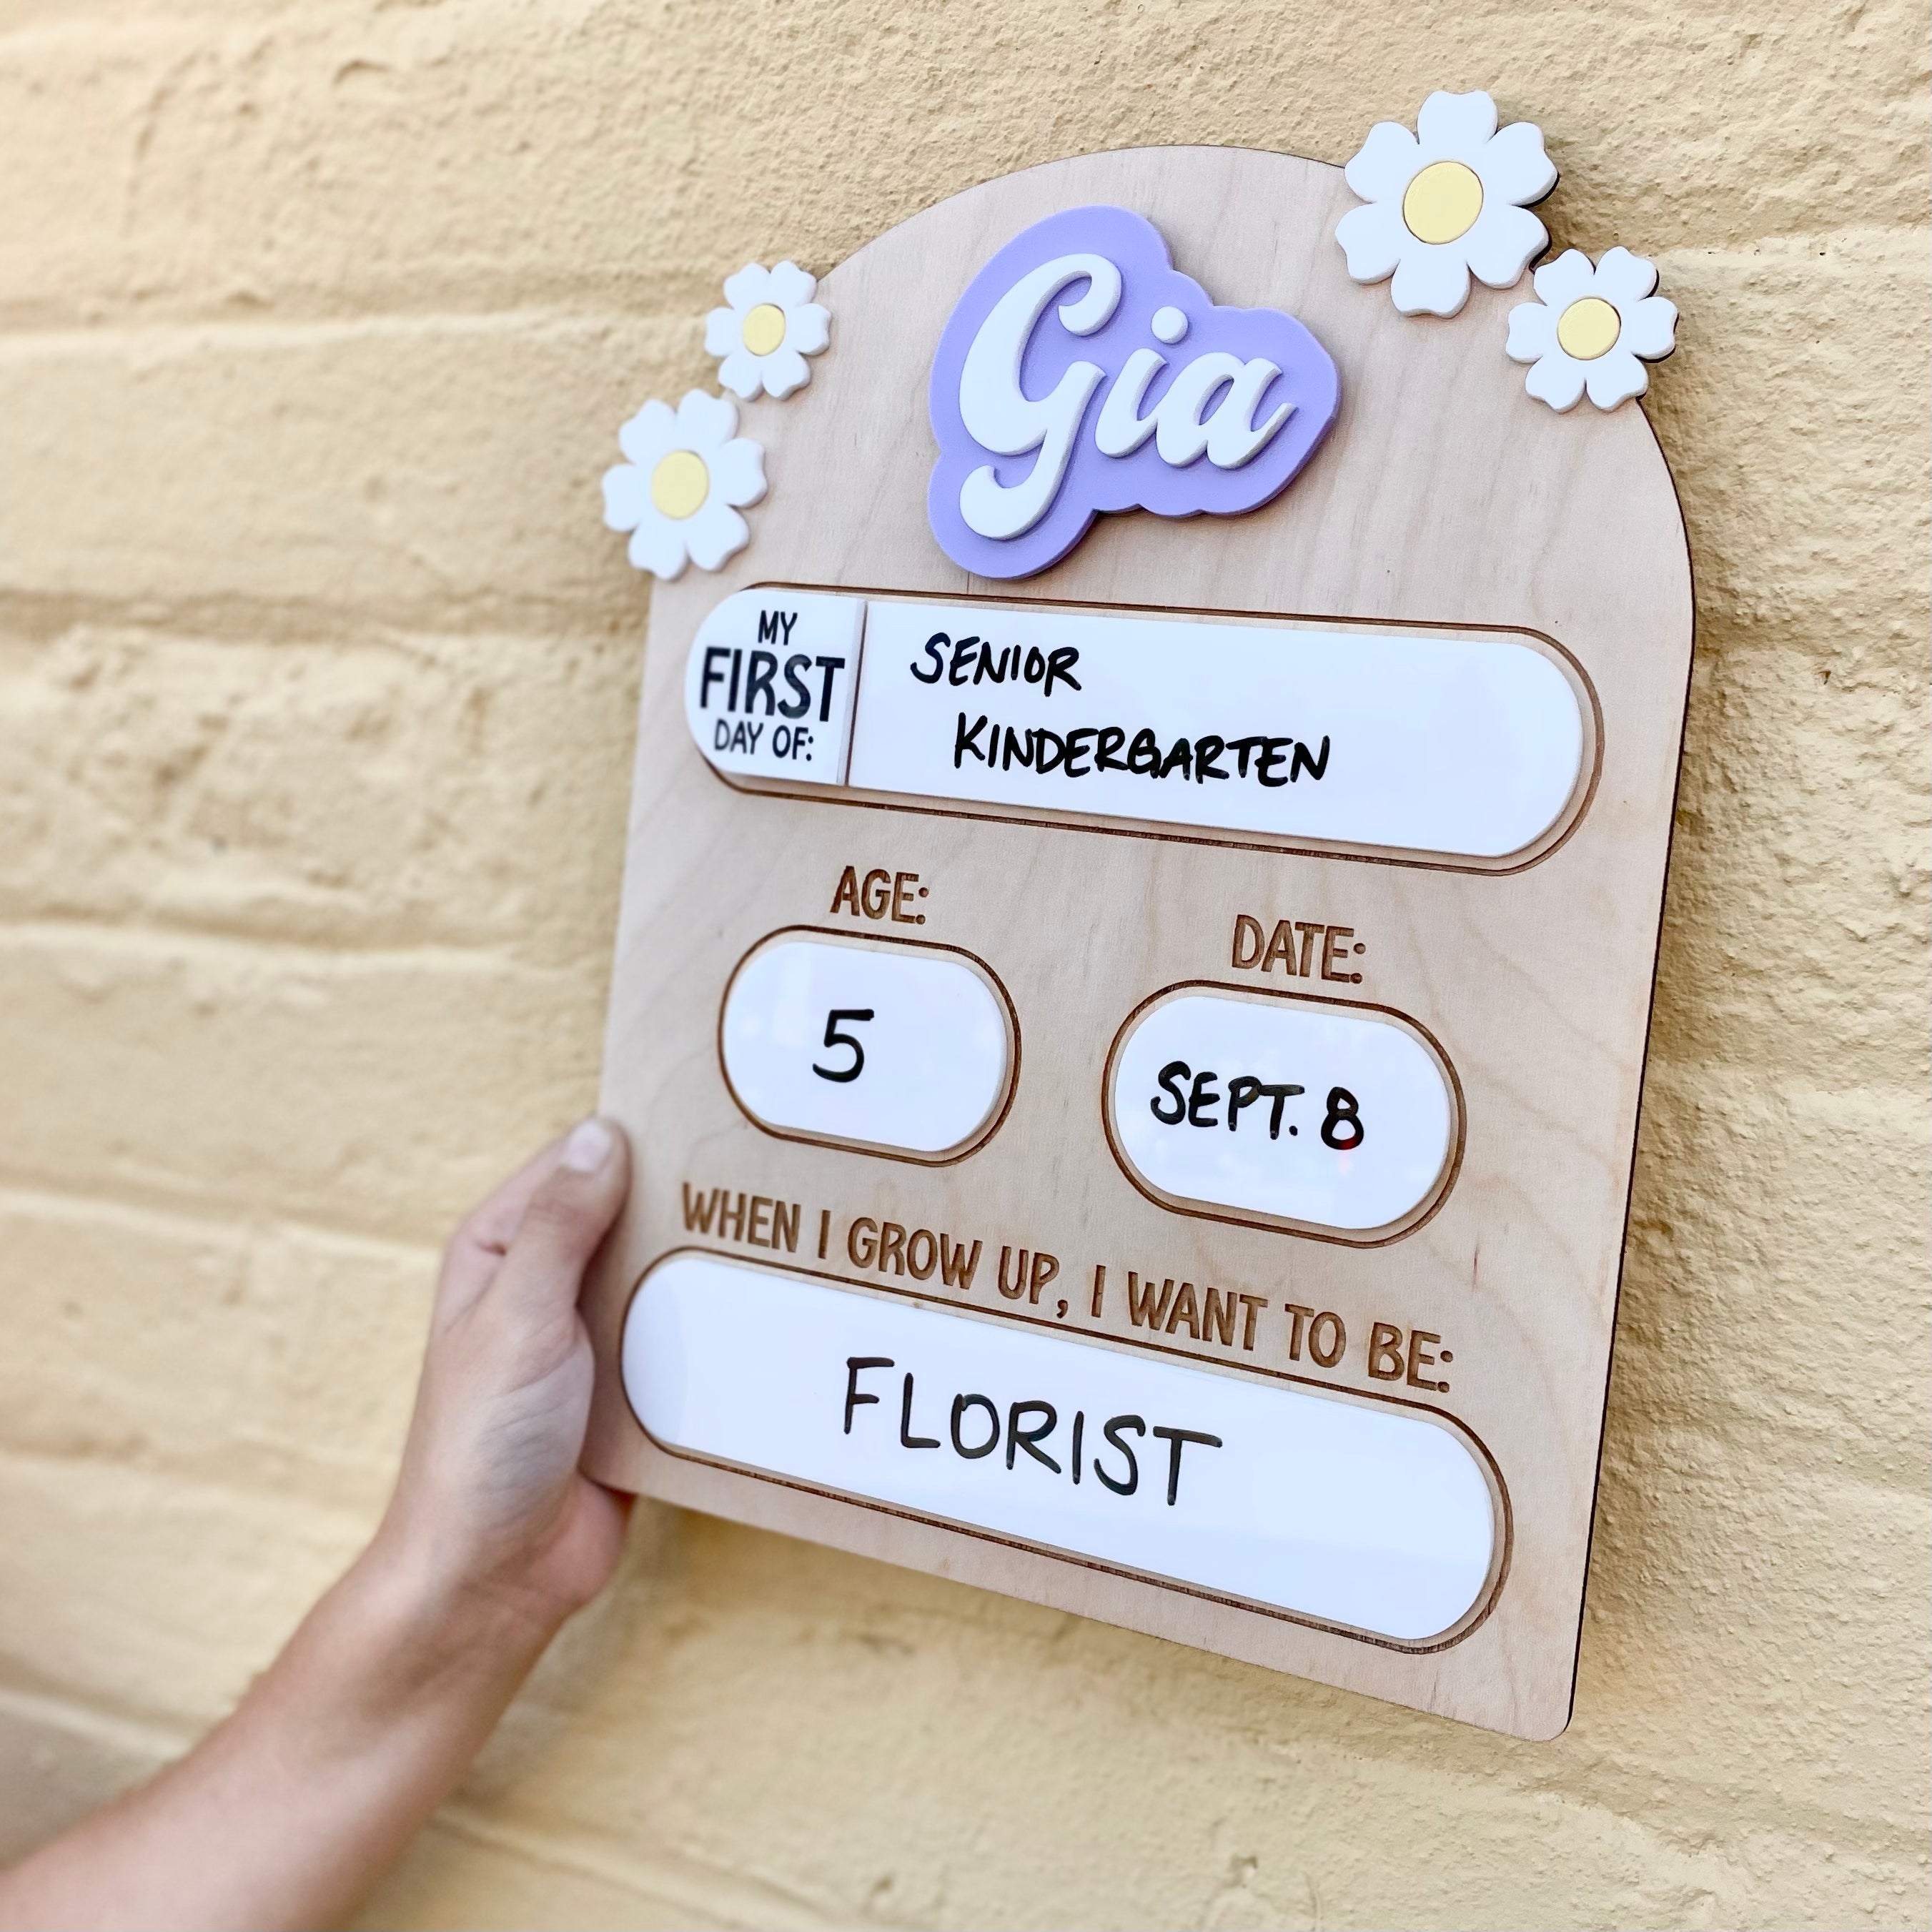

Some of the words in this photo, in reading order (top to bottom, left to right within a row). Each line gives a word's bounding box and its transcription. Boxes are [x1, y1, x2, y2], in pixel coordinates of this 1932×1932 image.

[958, 253, 1298, 541] Gia
[758, 610, 798, 645] MY
[910, 632, 1081, 697] SENIOR
[700, 646, 846, 722] FIRST
[714, 718, 763, 755] DAY
[772, 725, 814, 761] OF:
[954, 712, 1331, 787] KINDERGARTEN
[829, 865, 929, 926] AGE:
[1231, 914, 1367, 984] DATE:
[812, 1009, 875, 1083] 5
[1150, 1061, 1305, 1140] SEPT.
[1320, 1086, 1364, 1151] 8
[682, 1182, 801, 1254] WHEN
[818, 1209, 831, 1259] I
[847, 1217, 983, 1290] GROW
[998, 1245, 1069, 1319] UP,
[1091, 1264, 1106, 1318] I
[1128, 1271, 1269, 1352] WANT
[1284, 1303, 1347, 1368] TO
[1367, 1322, 1454, 1393] BE:
[843, 1357, 1223, 1506] FLORIST
